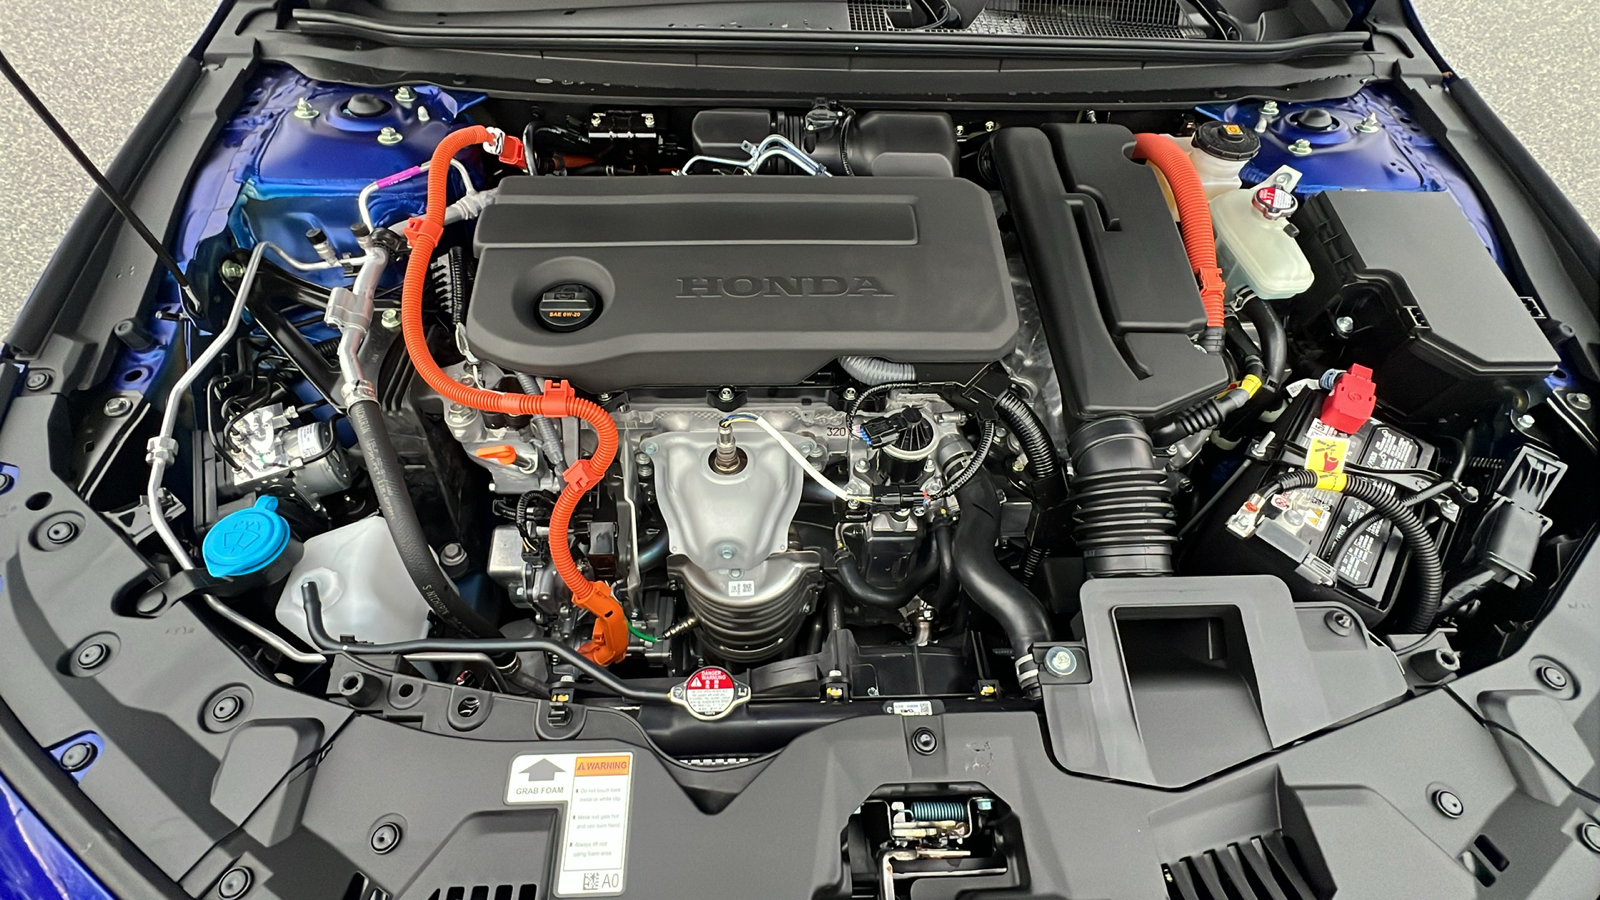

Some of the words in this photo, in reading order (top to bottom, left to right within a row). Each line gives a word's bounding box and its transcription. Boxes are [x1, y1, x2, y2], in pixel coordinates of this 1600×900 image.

[675, 276, 895, 298] HONDA
[826, 427, 847, 437] 320
[587, 761, 627, 770] WARNING
[516, 787, 539, 795] GRAB
[540, 786, 564, 794] FOAM
[601, 873, 620, 889] A0
